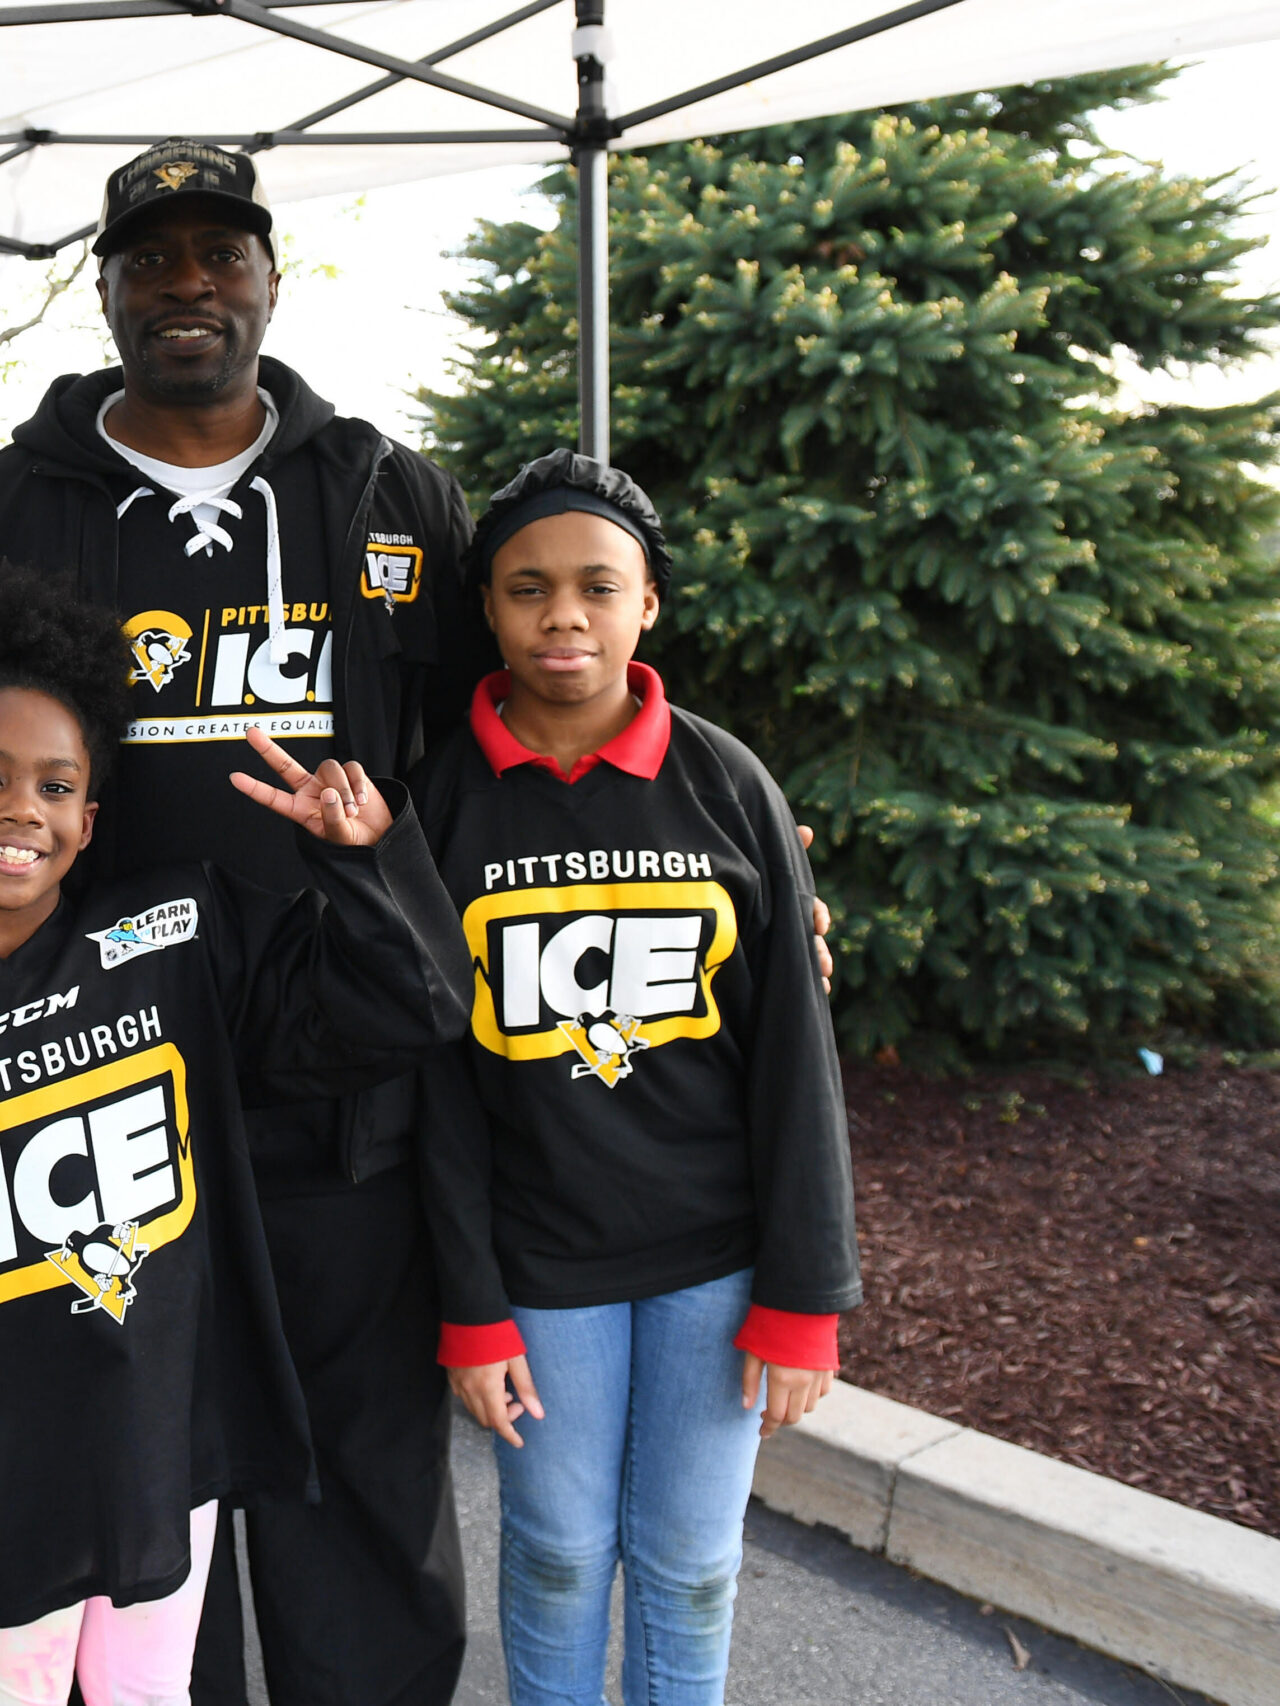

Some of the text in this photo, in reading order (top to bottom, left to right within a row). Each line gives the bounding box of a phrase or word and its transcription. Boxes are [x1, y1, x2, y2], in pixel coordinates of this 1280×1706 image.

[366, 552, 411, 591] ICE
[221, 602, 333, 627] PITTSBU
[483, 849, 713, 890] PITTSBURGH
[136, 903, 190, 929] LEARN
[151, 918, 192, 940] PLAY
[502, 914, 703, 1028] ICE
